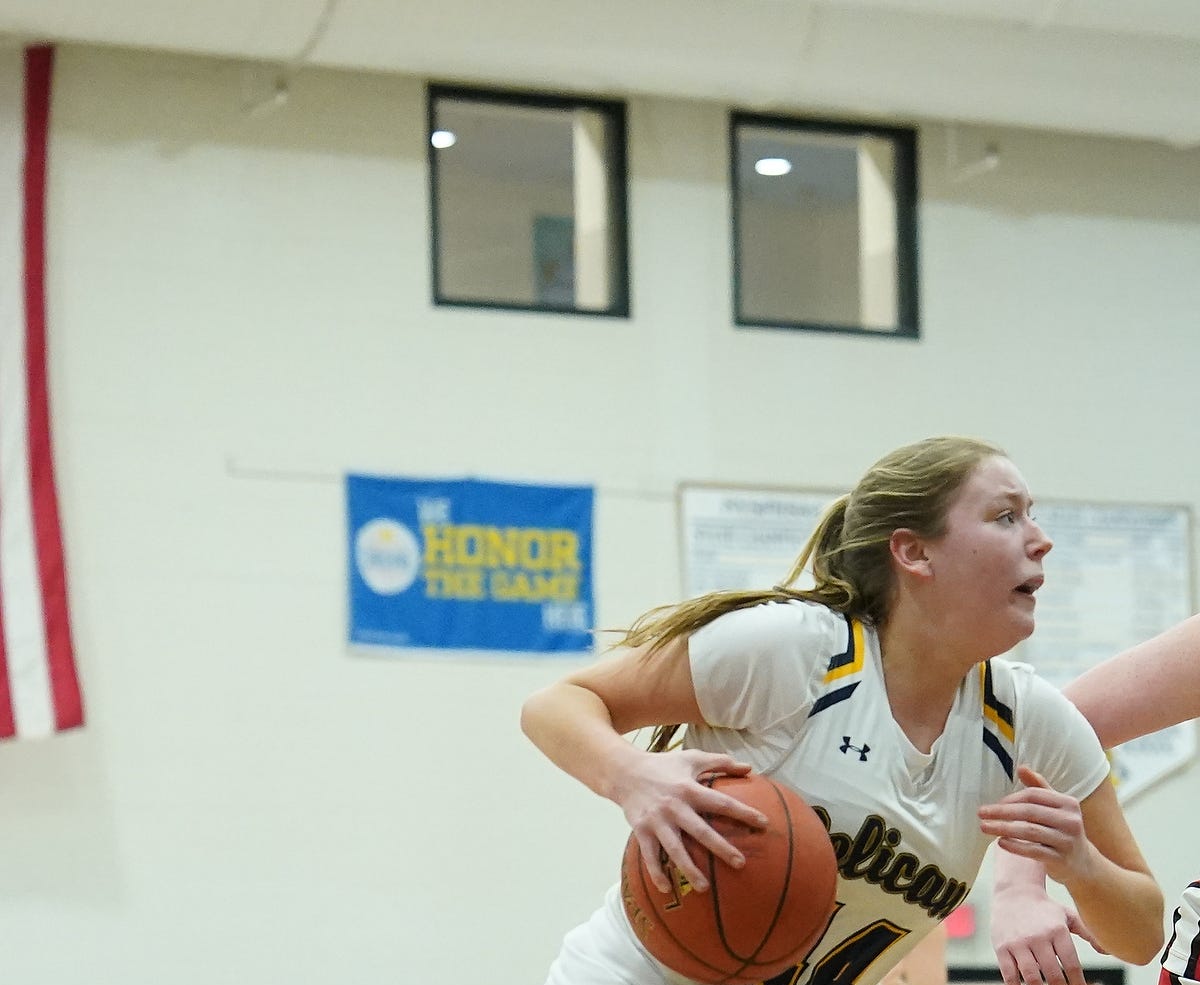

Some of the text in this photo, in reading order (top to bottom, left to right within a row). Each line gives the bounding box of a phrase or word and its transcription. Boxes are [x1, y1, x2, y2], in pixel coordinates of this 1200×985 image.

[424, 525, 578, 571] HONOR
[425, 571, 579, 602] THE GAME
